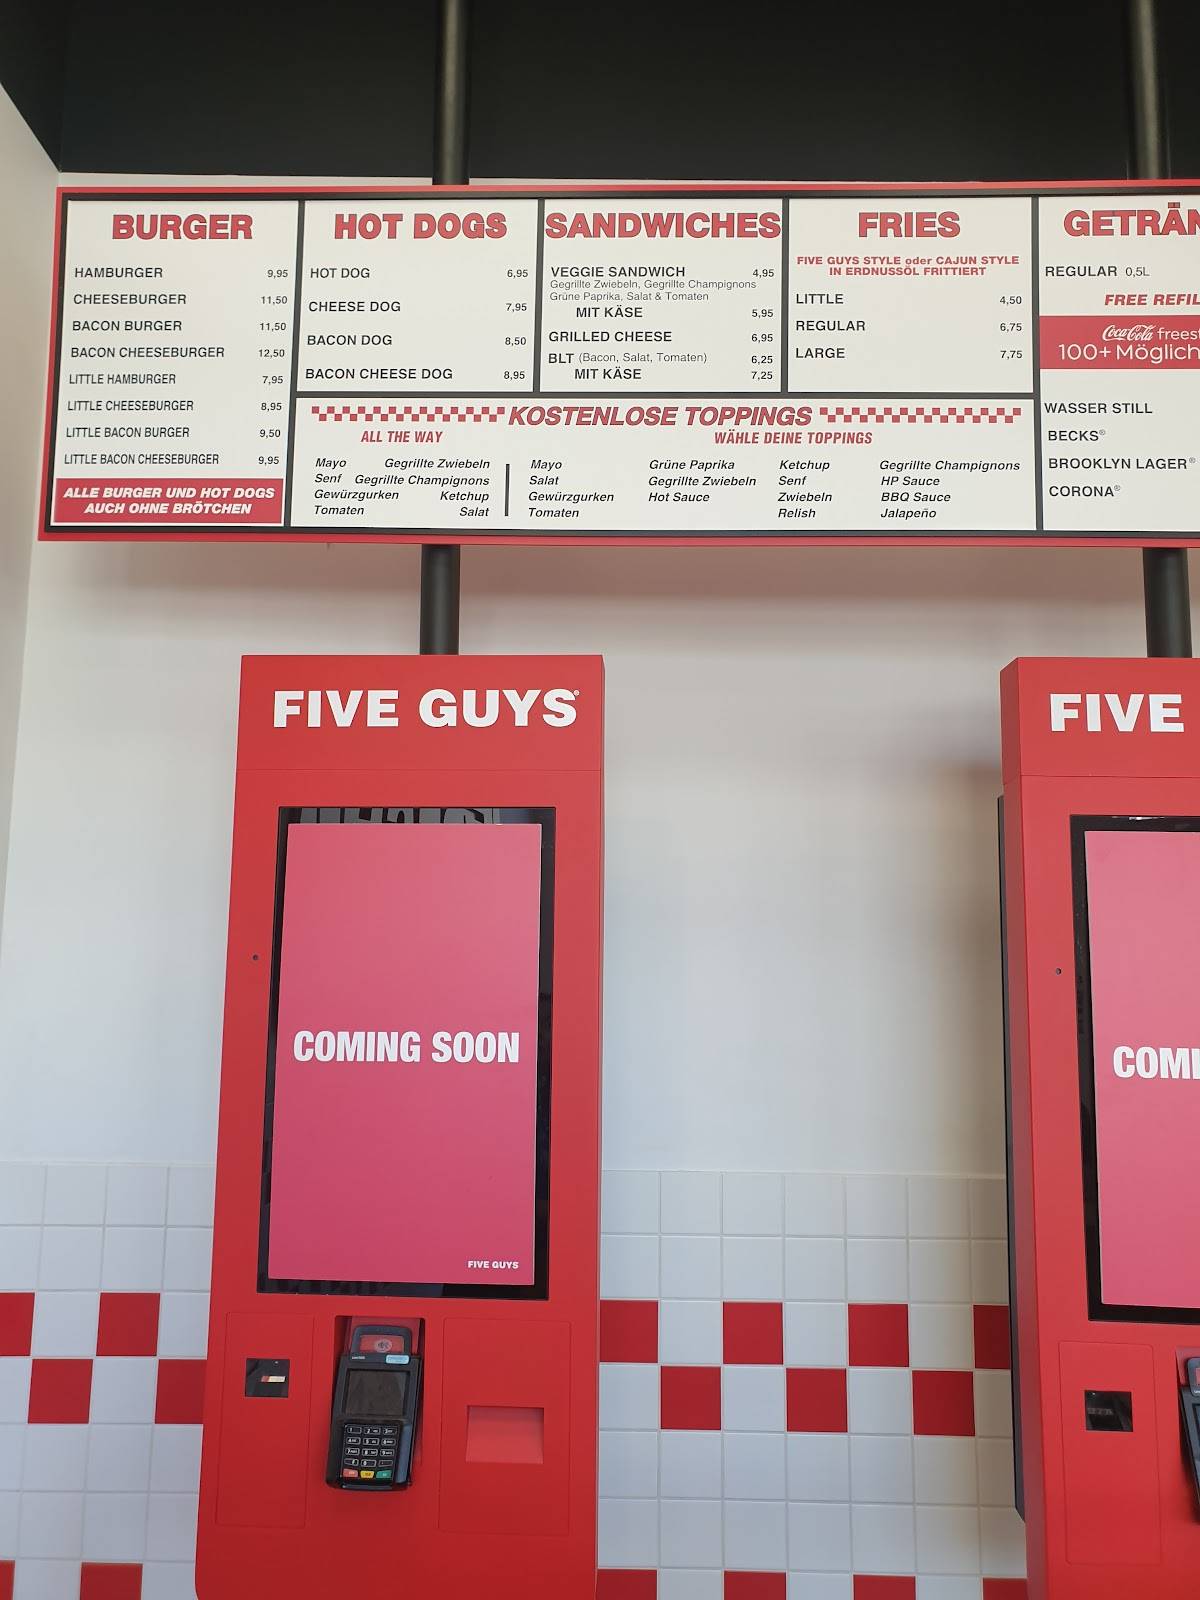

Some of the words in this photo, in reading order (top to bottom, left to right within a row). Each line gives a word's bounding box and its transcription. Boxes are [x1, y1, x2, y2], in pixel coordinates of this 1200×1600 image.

[112, 214, 252, 240] BURGER
[335, 213, 403, 239] HOT
[414, 213, 507, 239] DOGS
[545, 212, 781, 239] SANDWICHES
[859, 211, 960, 237] FRIES
[981, 256, 1019, 264] STYLE
[75, 268, 162, 277] HAMBURGER
[268, 270, 288, 278] 9,95
[311, 268, 337, 278] HOT
[342, 268, 369, 278] DOG
[508, 270, 528, 278] 6,95
[551, 267, 603, 277] VEGGIE
[609, 267, 684, 277] SANDWICH
[753, 269, 774, 278] 4,95
[830, 267, 841, 275] IN
[846, 265, 919, 275] ERDNUSSÖL
[924, 267, 986, 275] FRITTIERT
[1046, 266, 1117, 276] REGULAR
[1126, 267, 1149, 277] 0,5L
[551, 280, 590, 290] Gegrillte
[594, 280, 640, 288] Zwiebeln,
[645, 280, 684, 290] Gegrillte
[689, 280, 756, 290] Champignons
[74, 294, 186, 304] CHEESEBURGER
[262, 296, 287, 304] 11,50
[550, 292, 580, 300] Grüne
[584, 292, 622, 302] Paprika,
[627, 292, 651, 300] Salat
[655, 292, 661, 300] &
[665, 292, 708, 300] Tomaten
[797, 294, 843, 304] LITTLE
[1000, 296, 1021, 304] 4,50
[1105, 294, 1147, 305] FREE
[309, 302, 364, 311] CHEESE
[370, 302, 400, 311] DOG
[506, 303, 527, 312] 7,95
[577, 308, 600, 317] MIT
[605, 305, 642, 317] KÄSE
[752, 309, 773, 318] 5,95
[73, 321, 119, 331] BACON
[125, 321, 181, 330] BURGER
[260, 323, 286, 331] 11,50
[797, 321, 865, 331] REGULAR
[1000, 323, 1022, 331] 6,75
[308, 335, 356, 345] BACON
[362, 335, 391, 345] DOG
[505, 337, 526, 346] 8,50
[549, 332, 609, 341] GRILLED
[615, 332, 671, 341] CHEESE
[752, 334, 773, 342] 6,95
[71, 347, 115, 357] BACON
[120, 347, 224, 357] CHEESEBURGER
[259, 349, 284, 357] 12,50
[796, 348, 844, 358] LARGE
[1001, 351, 1022, 359] 7,75
[1059, 344, 1111, 360] 100+
[549, 353, 574, 363] BLT
[579, 353, 618, 363] (Bacon,
[623, 353, 652, 362] Salat,
[657, 353, 706, 363] Tomaten)
[752, 356, 772, 365] 6,25
[70, 374, 104, 384] LITTLE
[108, 374, 175, 384] HAMBURGER
[263, 376, 283, 384] 7,95
[306, 369, 354, 379] BACON
[360, 369, 416, 379] CHEESE
[422, 369, 452, 379] DOG
[504, 371, 525, 380] 8,95
[575, 369, 598, 379] MIT
[603, 367, 641, 379] KÄSE
[752, 372, 772, 381] 7,25
[68, 401, 102, 410] LITTLE
[106, 401, 193, 410] CHEESEBURGER
[261, 403, 281, 411] 8,95
[1045, 403, 1106, 413] WASSER
[1113, 403, 1152, 413] STILL
[509, 406, 679, 426] KOSTENLOSE
[685, 407, 812, 426] TOPPINGS
[67, 428, 101, 437] LITTLE
[105, 427, 141, 437] BACON
[145, 427, 189, 437] BURGER
[260, 429, 280, 438] 9,50
[361, 431, 382, 442] ALL
[388, 431, 410, 442] THE
[415, 431, 442, 442] WAY
[715, 429, 759, 444] WÄHLE
[764, 432, 802, 444] DEINE
[808, 432, 872, 444] TOPPINGS
[65, 454, 97, 464] LITTLE
[101, 454, 135, 464] BACON
[138, 454, 218, 464] CHEESEBURGER
[259, 456, 279, 465] 9,95
[316, 458, 346, 469] Mayo
[385, 459, 434, 470] Gegrillte
[437, 459, 489, 468] Zwiebeln
[1049, 458, 1130, 469] BROOKLYN
[531, 460, 562, 471] Mayo
[650, 460, 685, 469] Grüne
[690, 460, 734, 471] Paprika
[780, 460, 829, 471] Ketchup
[880, 461, 931, 472] Gegrillte
[936, 461, 1020, 472] Champignons
[315, 474, 342, 482] Senf
[355, 475, 404, 486] Gegrillte
[409, 475, 489, 487] Champignons
[530, 476, 558, 485] Salat
[649, 477, 698, 488] Gegrillte
[702, 477, 756, 485] Zwiebeln
[779, 476, 806, 485] Senf
[881, 477, 898, 485] HP
[903, 476, 939, 485] Sauce
[63, 488, 100, 498] ALLE
[103, 488, 162, 498] BURGER
[166, 488, 196, 498] UND
[200, 488, 231, 498] HOT
[233, 488, 275, 499] DOGS
[315, 490, 398, 501] Gewürzgurken
[440, 491, 489, 503] Ketchup
[529, 492, 614, 503] Gewürzgurken
[649, 493, 669, 501] Hot
[673, 492, 709, 501] Sauce
[778, 492, 832, 501] Zwiebeln
[881, 492, 909, 501] BBQ
[913, 492, 950, 501] Sauce
[84, 503, 125, 513] AUCH
[129, 503, 169, 513] OHNE
[172, 501, 252, 514] BRÖTCHEN
[315, 506, 364, 514] Tomaten
[460, 507, 489, 516] Salat
[529, 508, 579, 517] Tomaten
[778, 509, 815, 517] Relish
[881, 509, 936, 520] Jalapeño
[273, 690, 399, 728] FIVE
[1050, 693, 1184, 732] FIVE
[294, 1031, 420, 1062] COMING
[432, 1031, 519, 1063] SOON
[1114, 1046, 1200, 1080] COMI
[491, 1261, 518, 1269] GUYS
